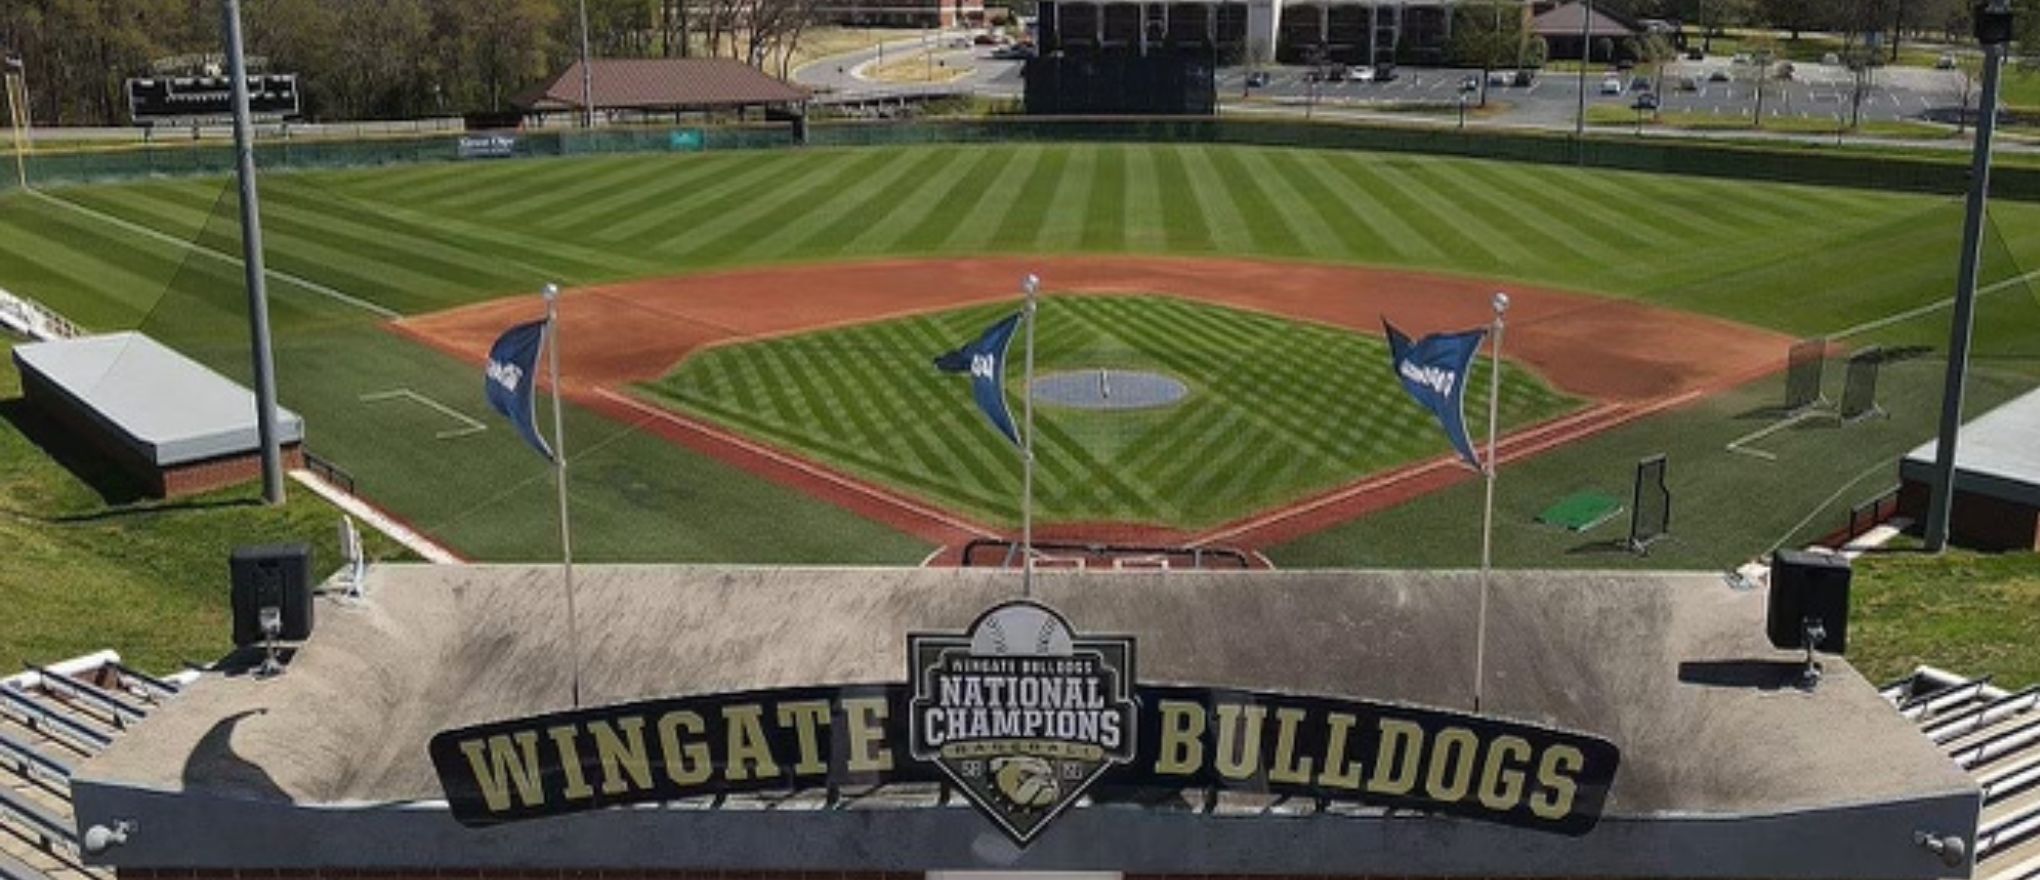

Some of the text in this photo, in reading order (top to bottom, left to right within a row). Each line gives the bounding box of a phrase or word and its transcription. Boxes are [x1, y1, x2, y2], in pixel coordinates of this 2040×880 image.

[939, 675, 1105, 709] NATIONAL
[924, 706, 1121, 747] CHAMPIONS
[459, 697, 1584, 820] WINGATE BULLDOGS
